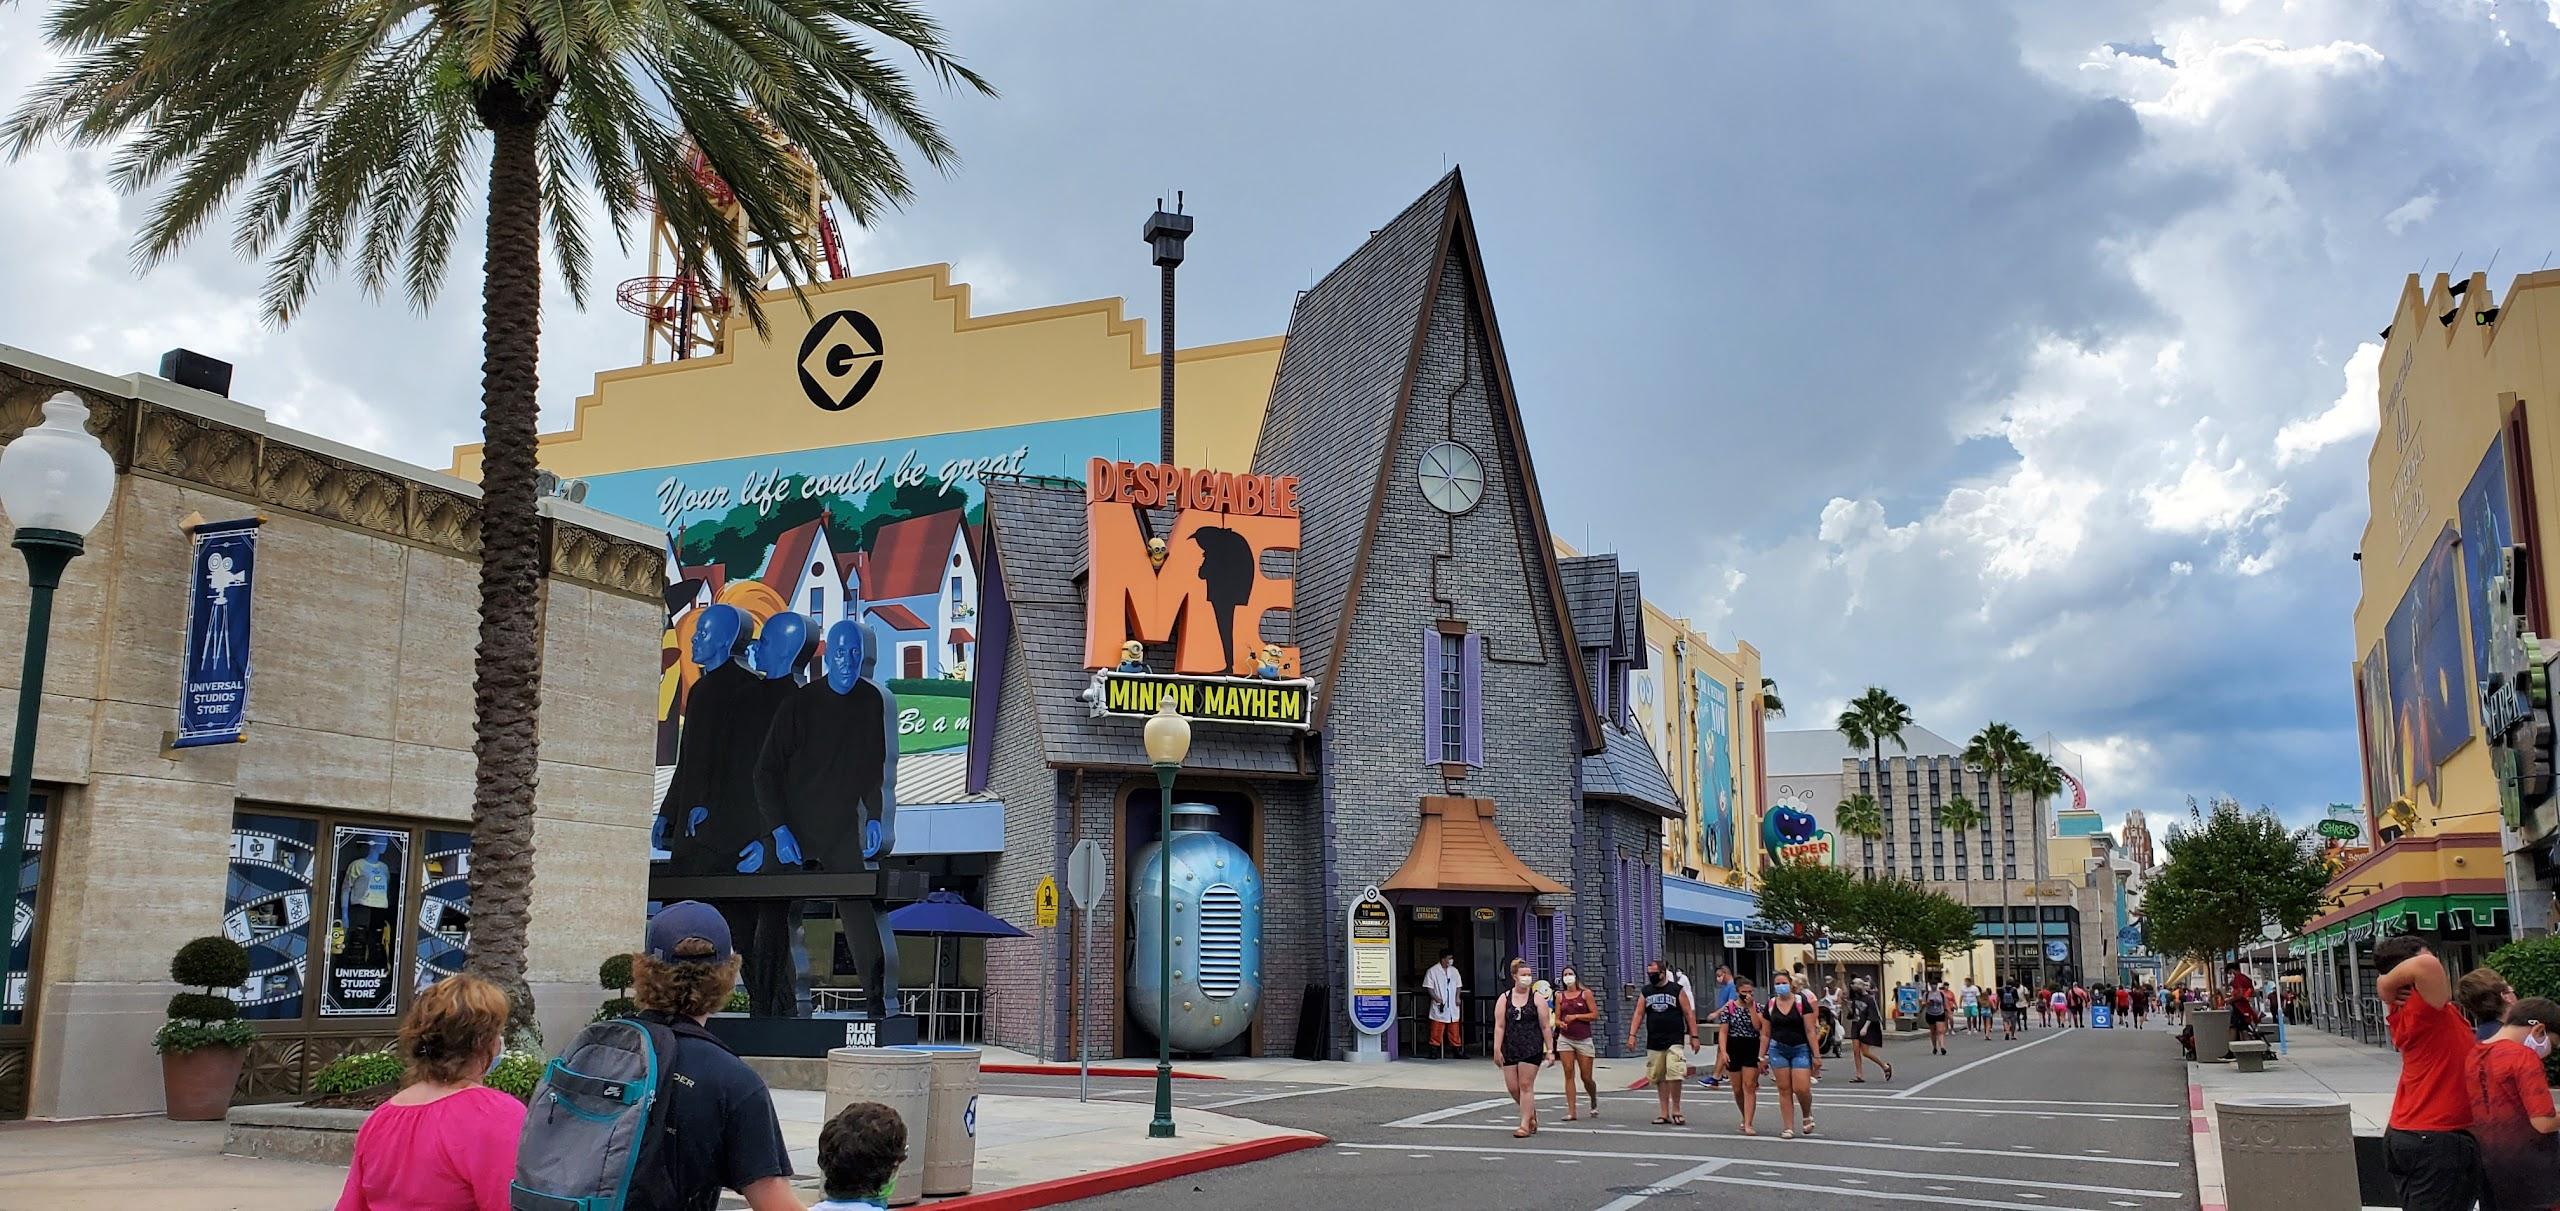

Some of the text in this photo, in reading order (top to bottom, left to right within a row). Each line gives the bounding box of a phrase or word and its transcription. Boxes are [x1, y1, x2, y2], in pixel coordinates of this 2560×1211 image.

[656, 445, 1029, 527] Your life could be great
[1088, 457, 1299, 518] DESPICABLE
[1085, 502, 1301, 680] ME
[189, 680, 244, 693] UNIVERSAL
[193, 692, 236, 704] STUDIOS
[1109, 679, 1301, 722] MINION MAYHEM
[196, 704, 230, 715] STORE
[898, 707, 927, 734] Be
[932, 716, 948, 732] a
[2321, 822, 2357, 838] SHREK'S
[1781, 842, 1829, 859] SUPER
[335, 968, 388, 979] UNIVERSAL
[340, 979, 381, 988] STUDIOS
[344, 988, 376, 999] STORE
[846, 1022, 876, 1034] BLUE
[846, 1033, 876, 1046] MAN
